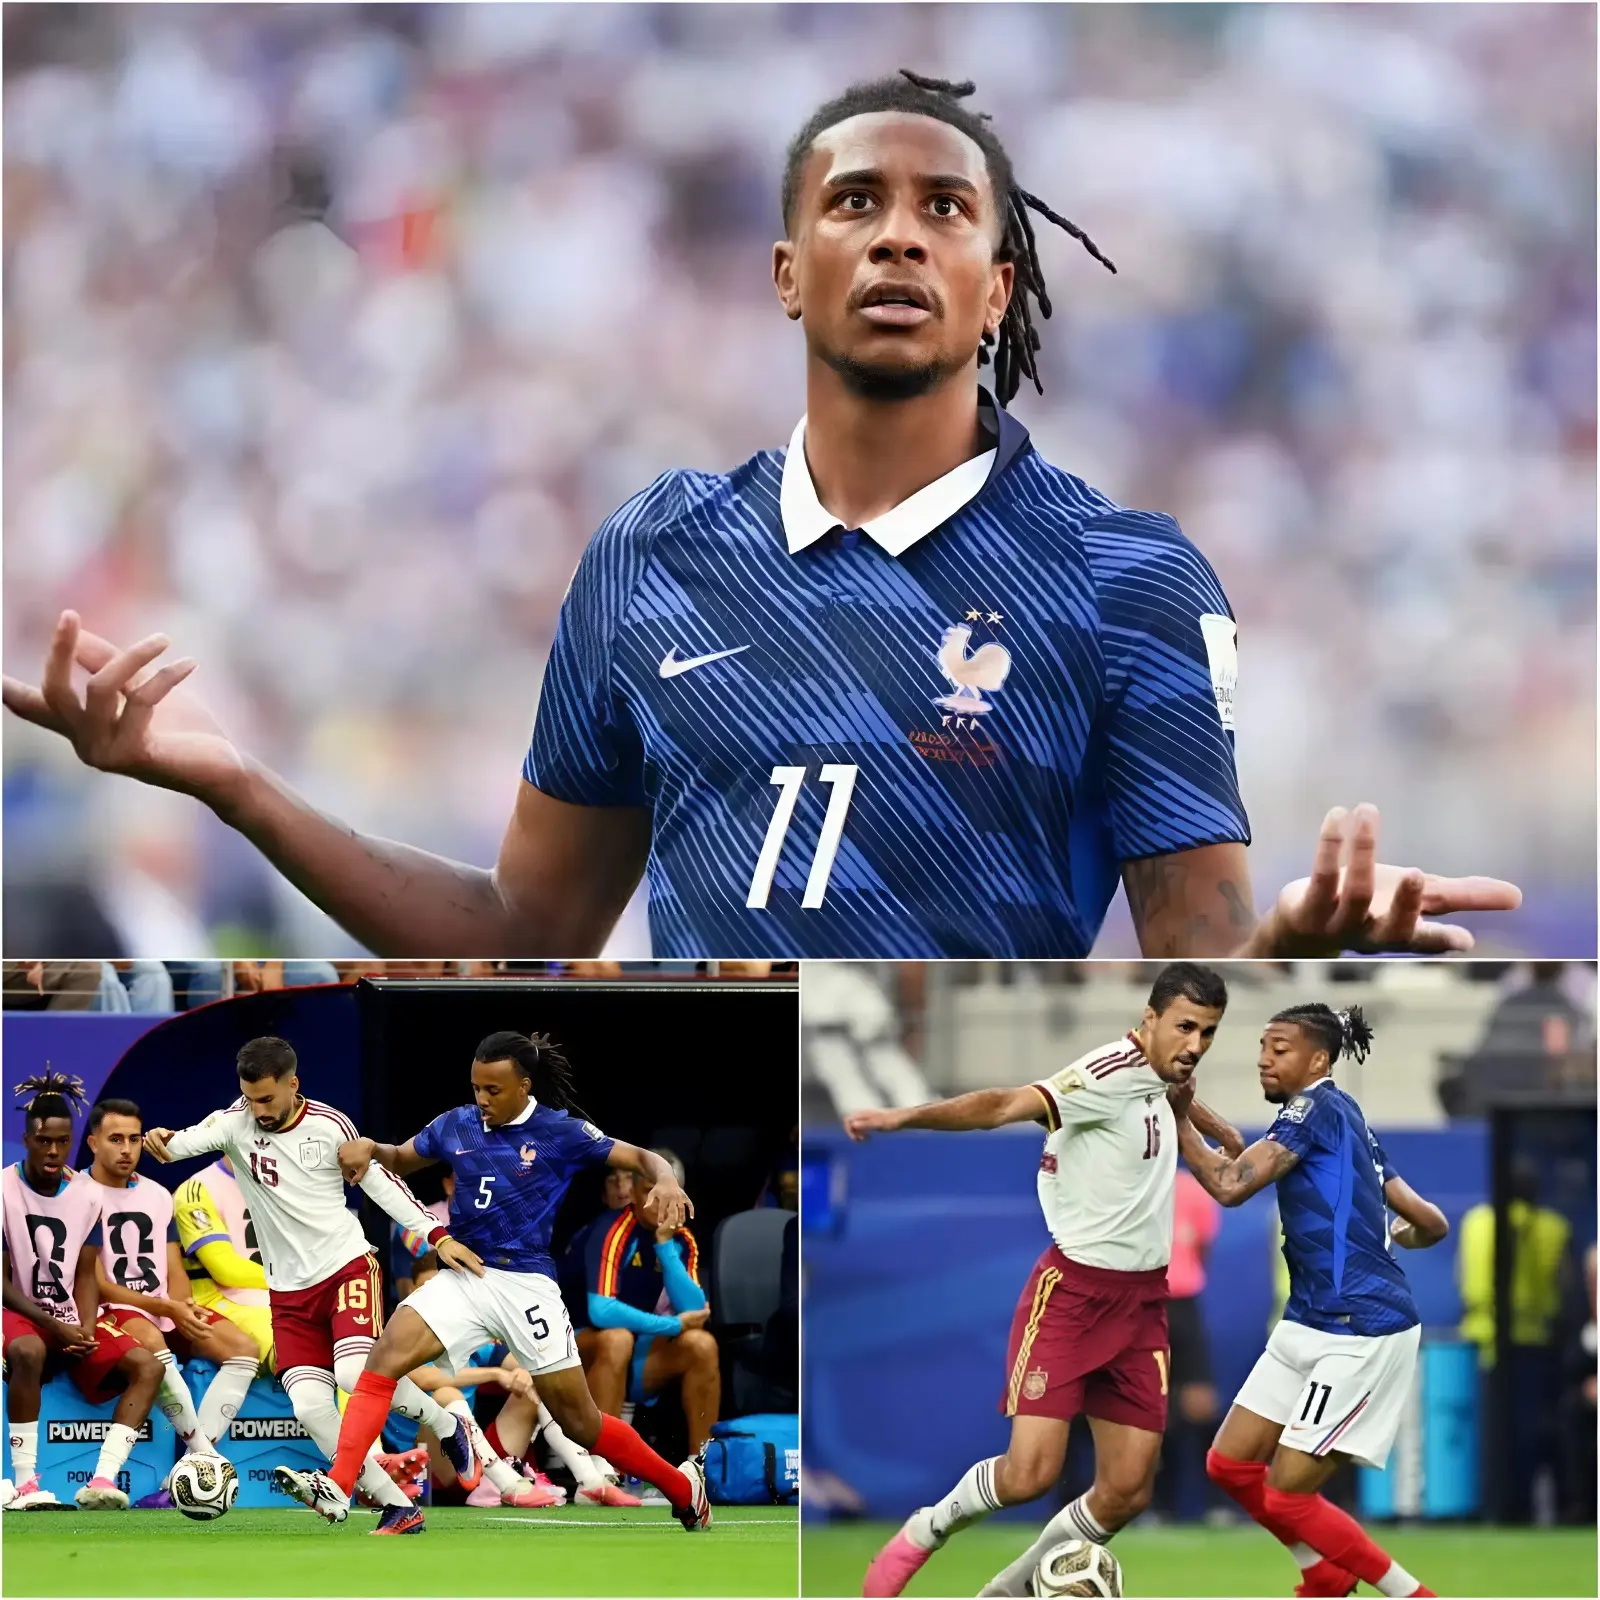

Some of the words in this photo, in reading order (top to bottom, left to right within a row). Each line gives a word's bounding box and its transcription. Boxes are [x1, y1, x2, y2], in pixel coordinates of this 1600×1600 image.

[746, 764, 858, 909] 11
[250, 1152, 279, 1187] 15
[474, 1176, 496, 1210] 5
[126, 1280, 149, 1292] FIFA
[337, 1278, 368, 1313] 15
[524, 1305, 550, 1340] 5
[1300, 1381, 1332, 1425] 11
[49, 1422, 149, 1441] POWERE
[230, 1420, 310, 1438] POWERA
